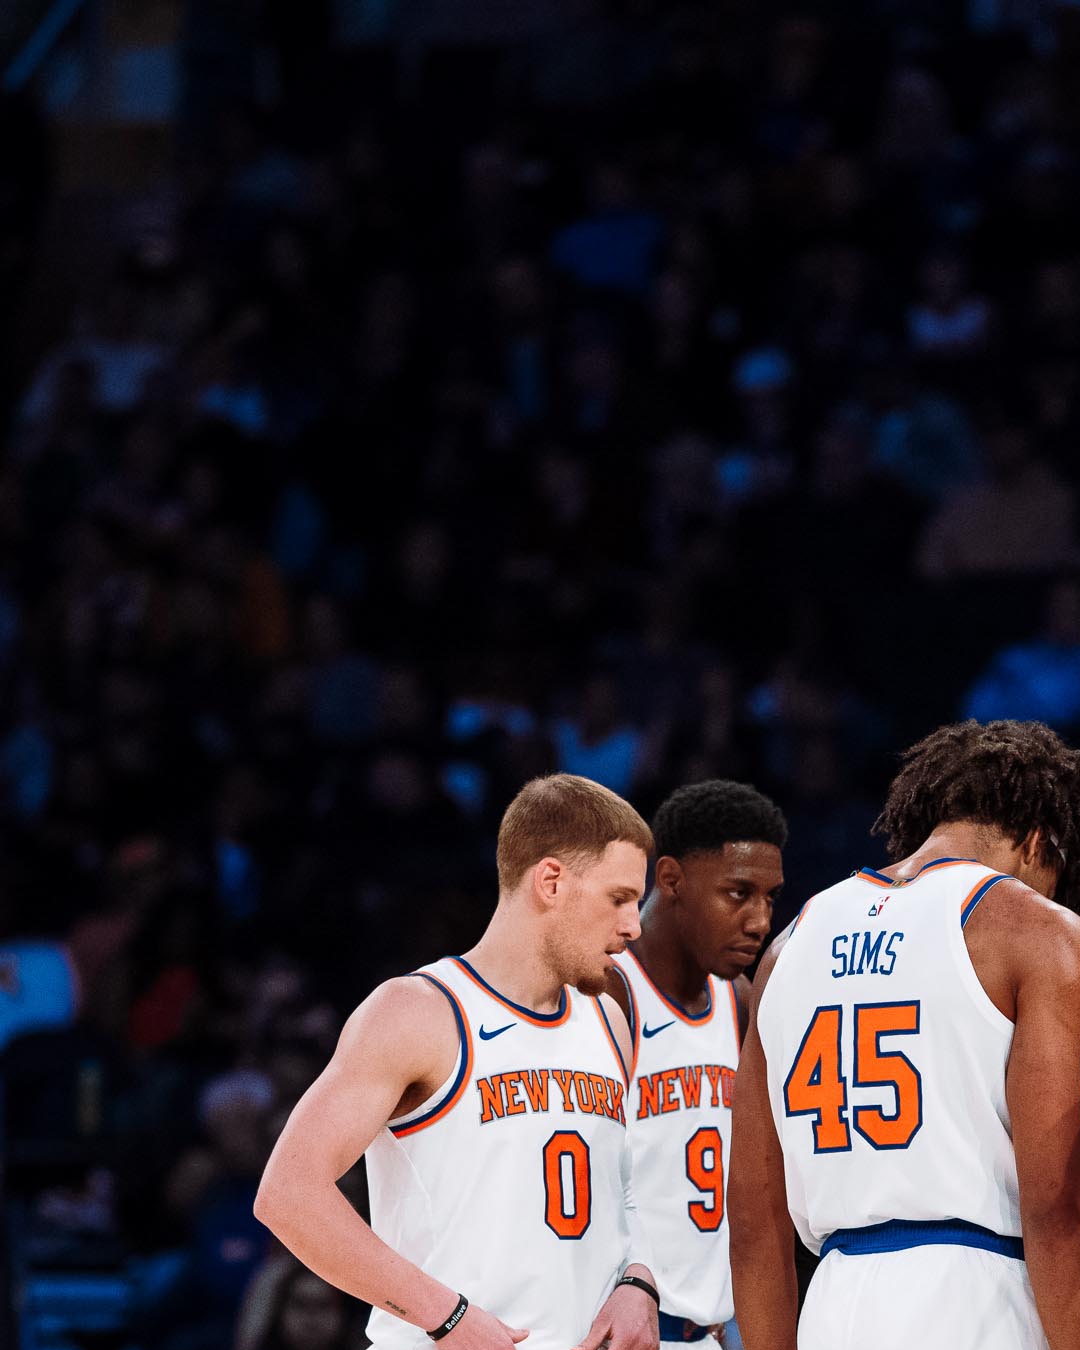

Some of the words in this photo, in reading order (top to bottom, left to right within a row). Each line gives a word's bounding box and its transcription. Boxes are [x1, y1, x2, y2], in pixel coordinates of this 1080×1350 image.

[831, 930, 905, 979] SIMS
[477, 1069, 551, 1127] NEW
[551, 1068, 628, 1129] YORK
[636, 1065, 702, 1122] NEW
[783, 999, 924, 1155] 45
[542, 1130, 592, 1241] 0
[685, 1126, 725, 1233] 9
[445, 1304, 466, 1330] Believe
